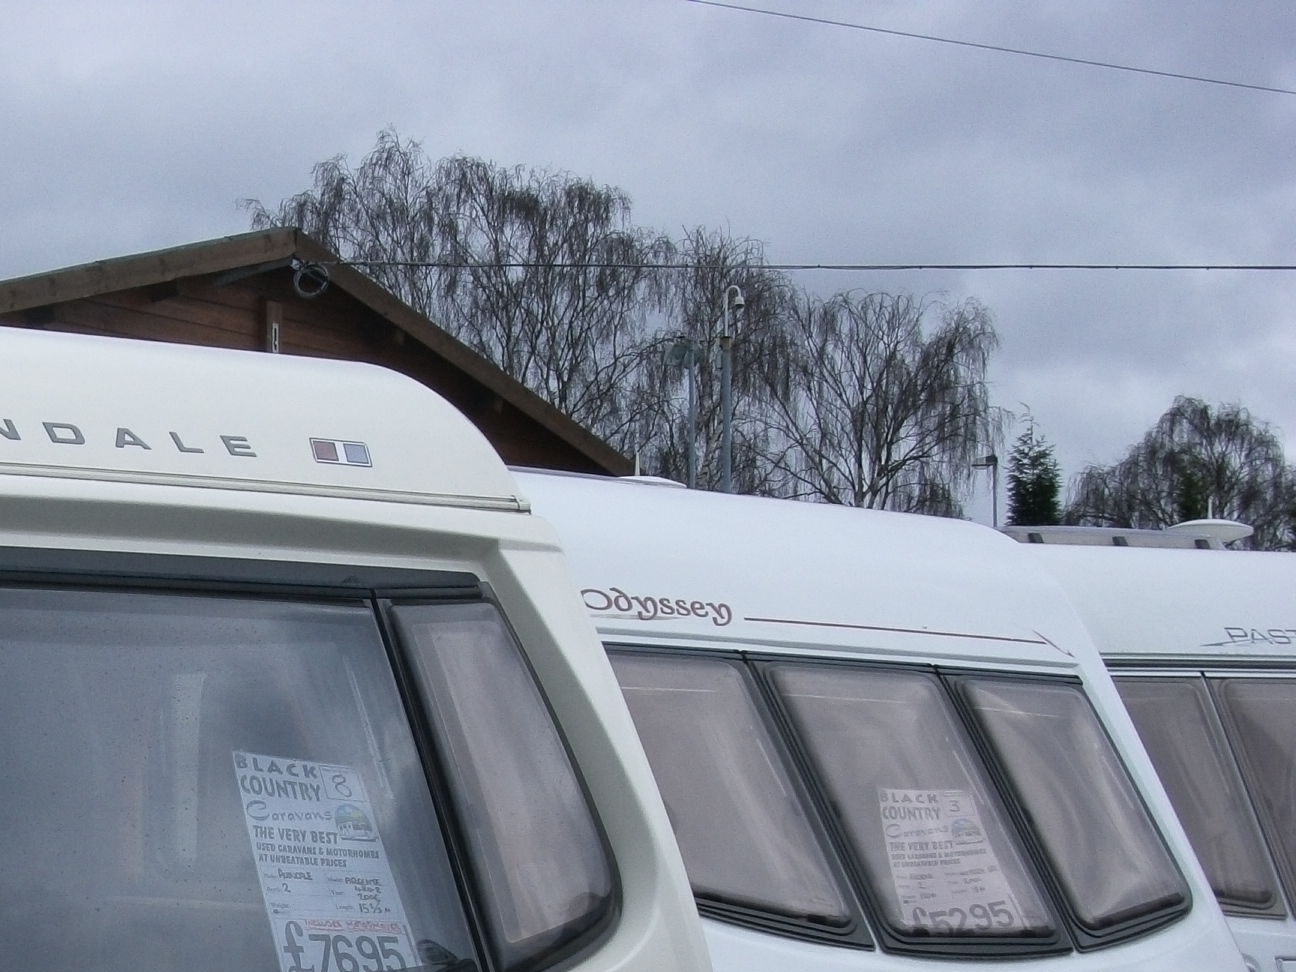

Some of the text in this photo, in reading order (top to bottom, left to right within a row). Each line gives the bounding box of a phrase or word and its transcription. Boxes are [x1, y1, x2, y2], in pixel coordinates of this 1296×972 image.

[580, 587, 733, 627] Odyssey
[236, 757, 318, 779] BLACK
[240, 775, 321, 801] COUNTRY
[246, 800, 333, 821] Caravans
[882, 806, 941, 820] COUNTRY
[252, 825, 338, 844] THE VERY BEST
[256, 841, 276, 852] USED
[278, 844, 317, 856] CARAVANS
[326, 847, 380, 860] MOTORHOMES
[259, 853, 347, 868] AT UNBEATABLE PRICES
